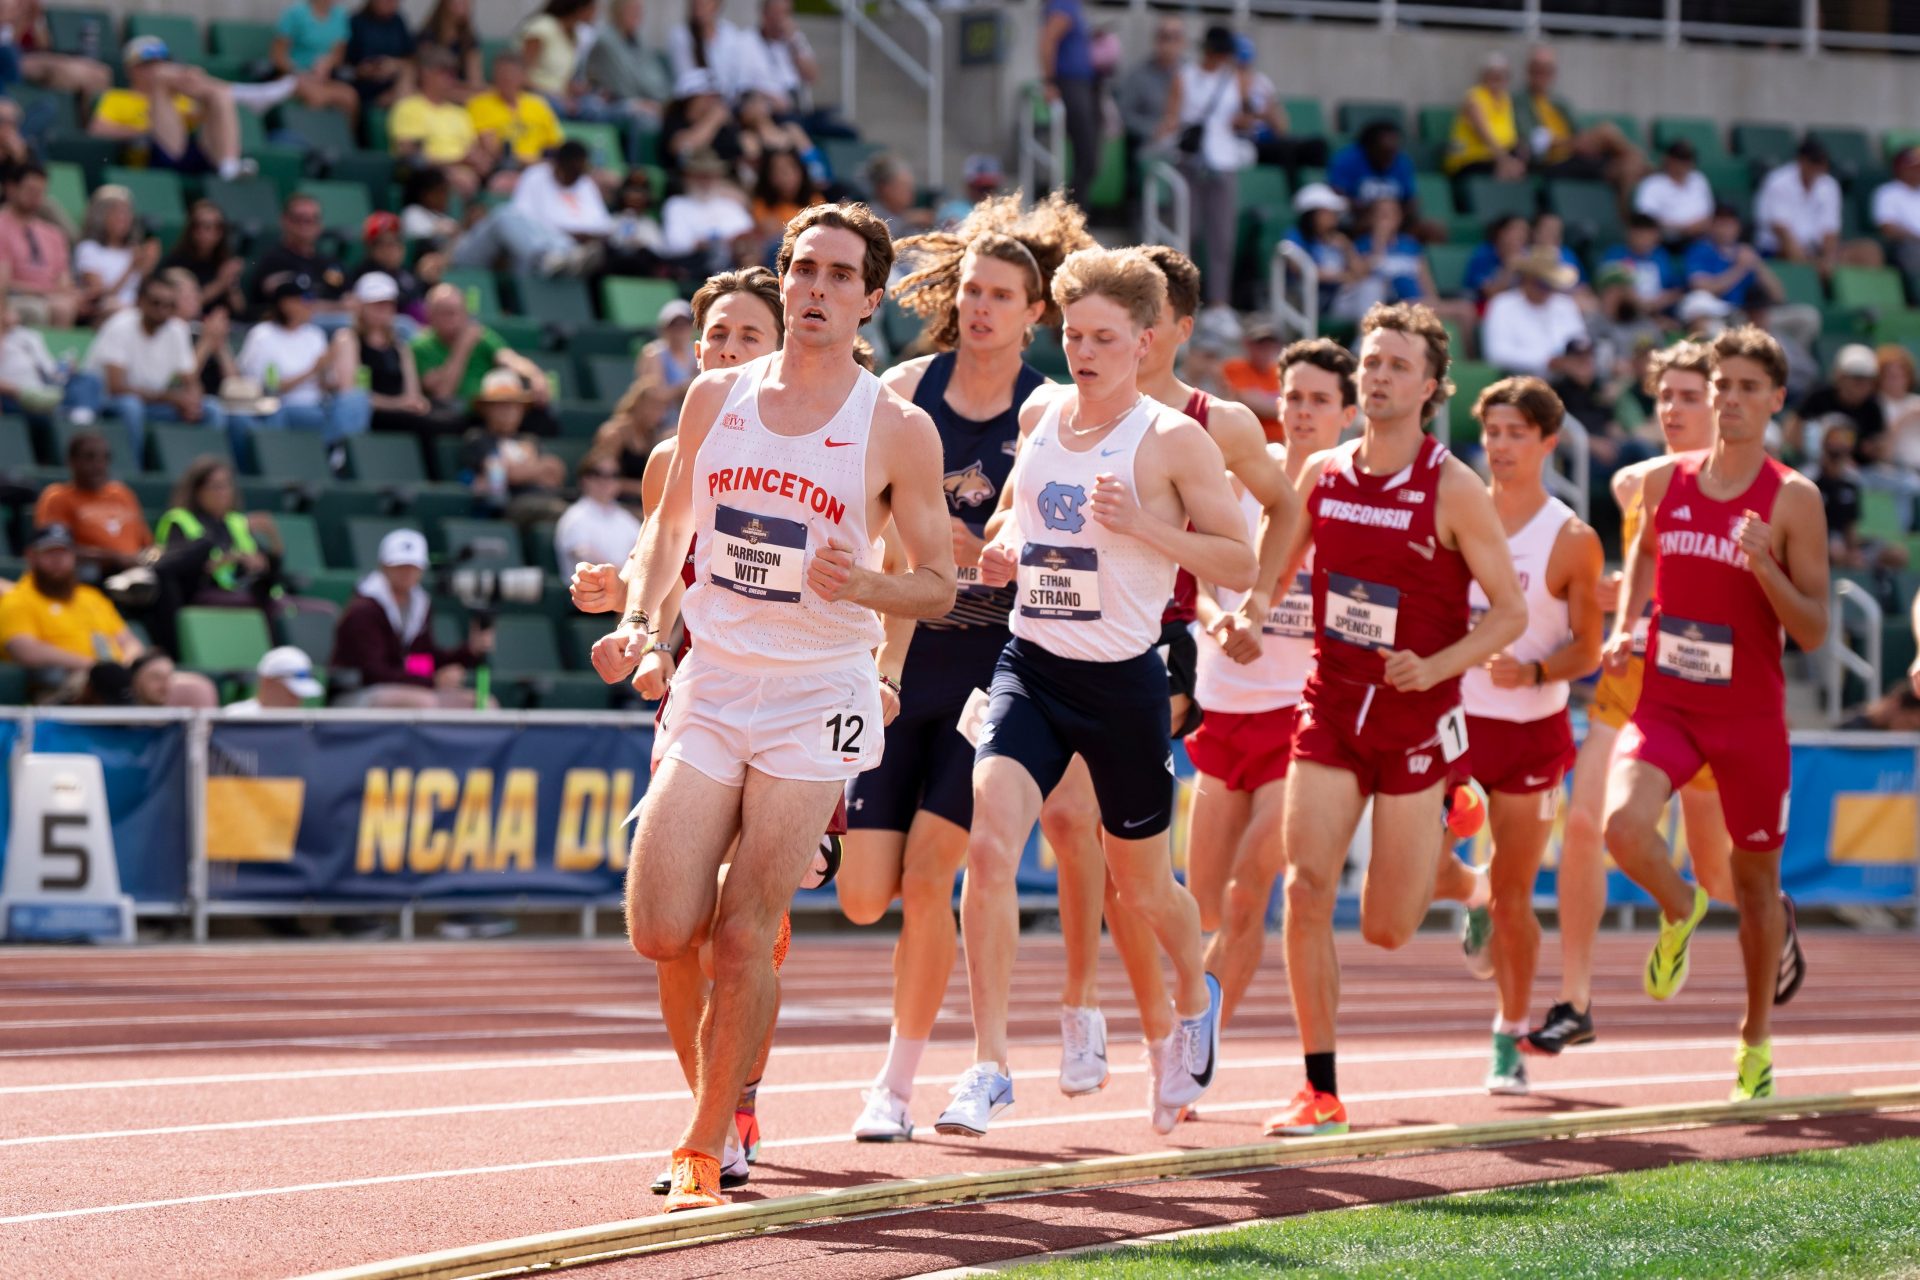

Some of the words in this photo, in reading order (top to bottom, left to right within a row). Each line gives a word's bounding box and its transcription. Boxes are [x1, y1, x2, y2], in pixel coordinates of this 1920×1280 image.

[708, 467, 846, 526] PRINCETON
[1319, 498, 1414, 531] WISCONSIN
[727, 543, 781, 567] HARRISON
[735, 562, 768, 585] WITT
[1039, 574, 1071, 588] ETHAN
[1030, 589, 1081, 607] STRAND
[1266, 611, 1315, 628] ACKETT
[1346, 605, 1371, 620] ADAM
[1335, 616, 1383, 639] SPENCER
[826, 713, 864, 754] 12
[356, 767, 539, 873] NCAA
[41, 814, 90, 890] 5
